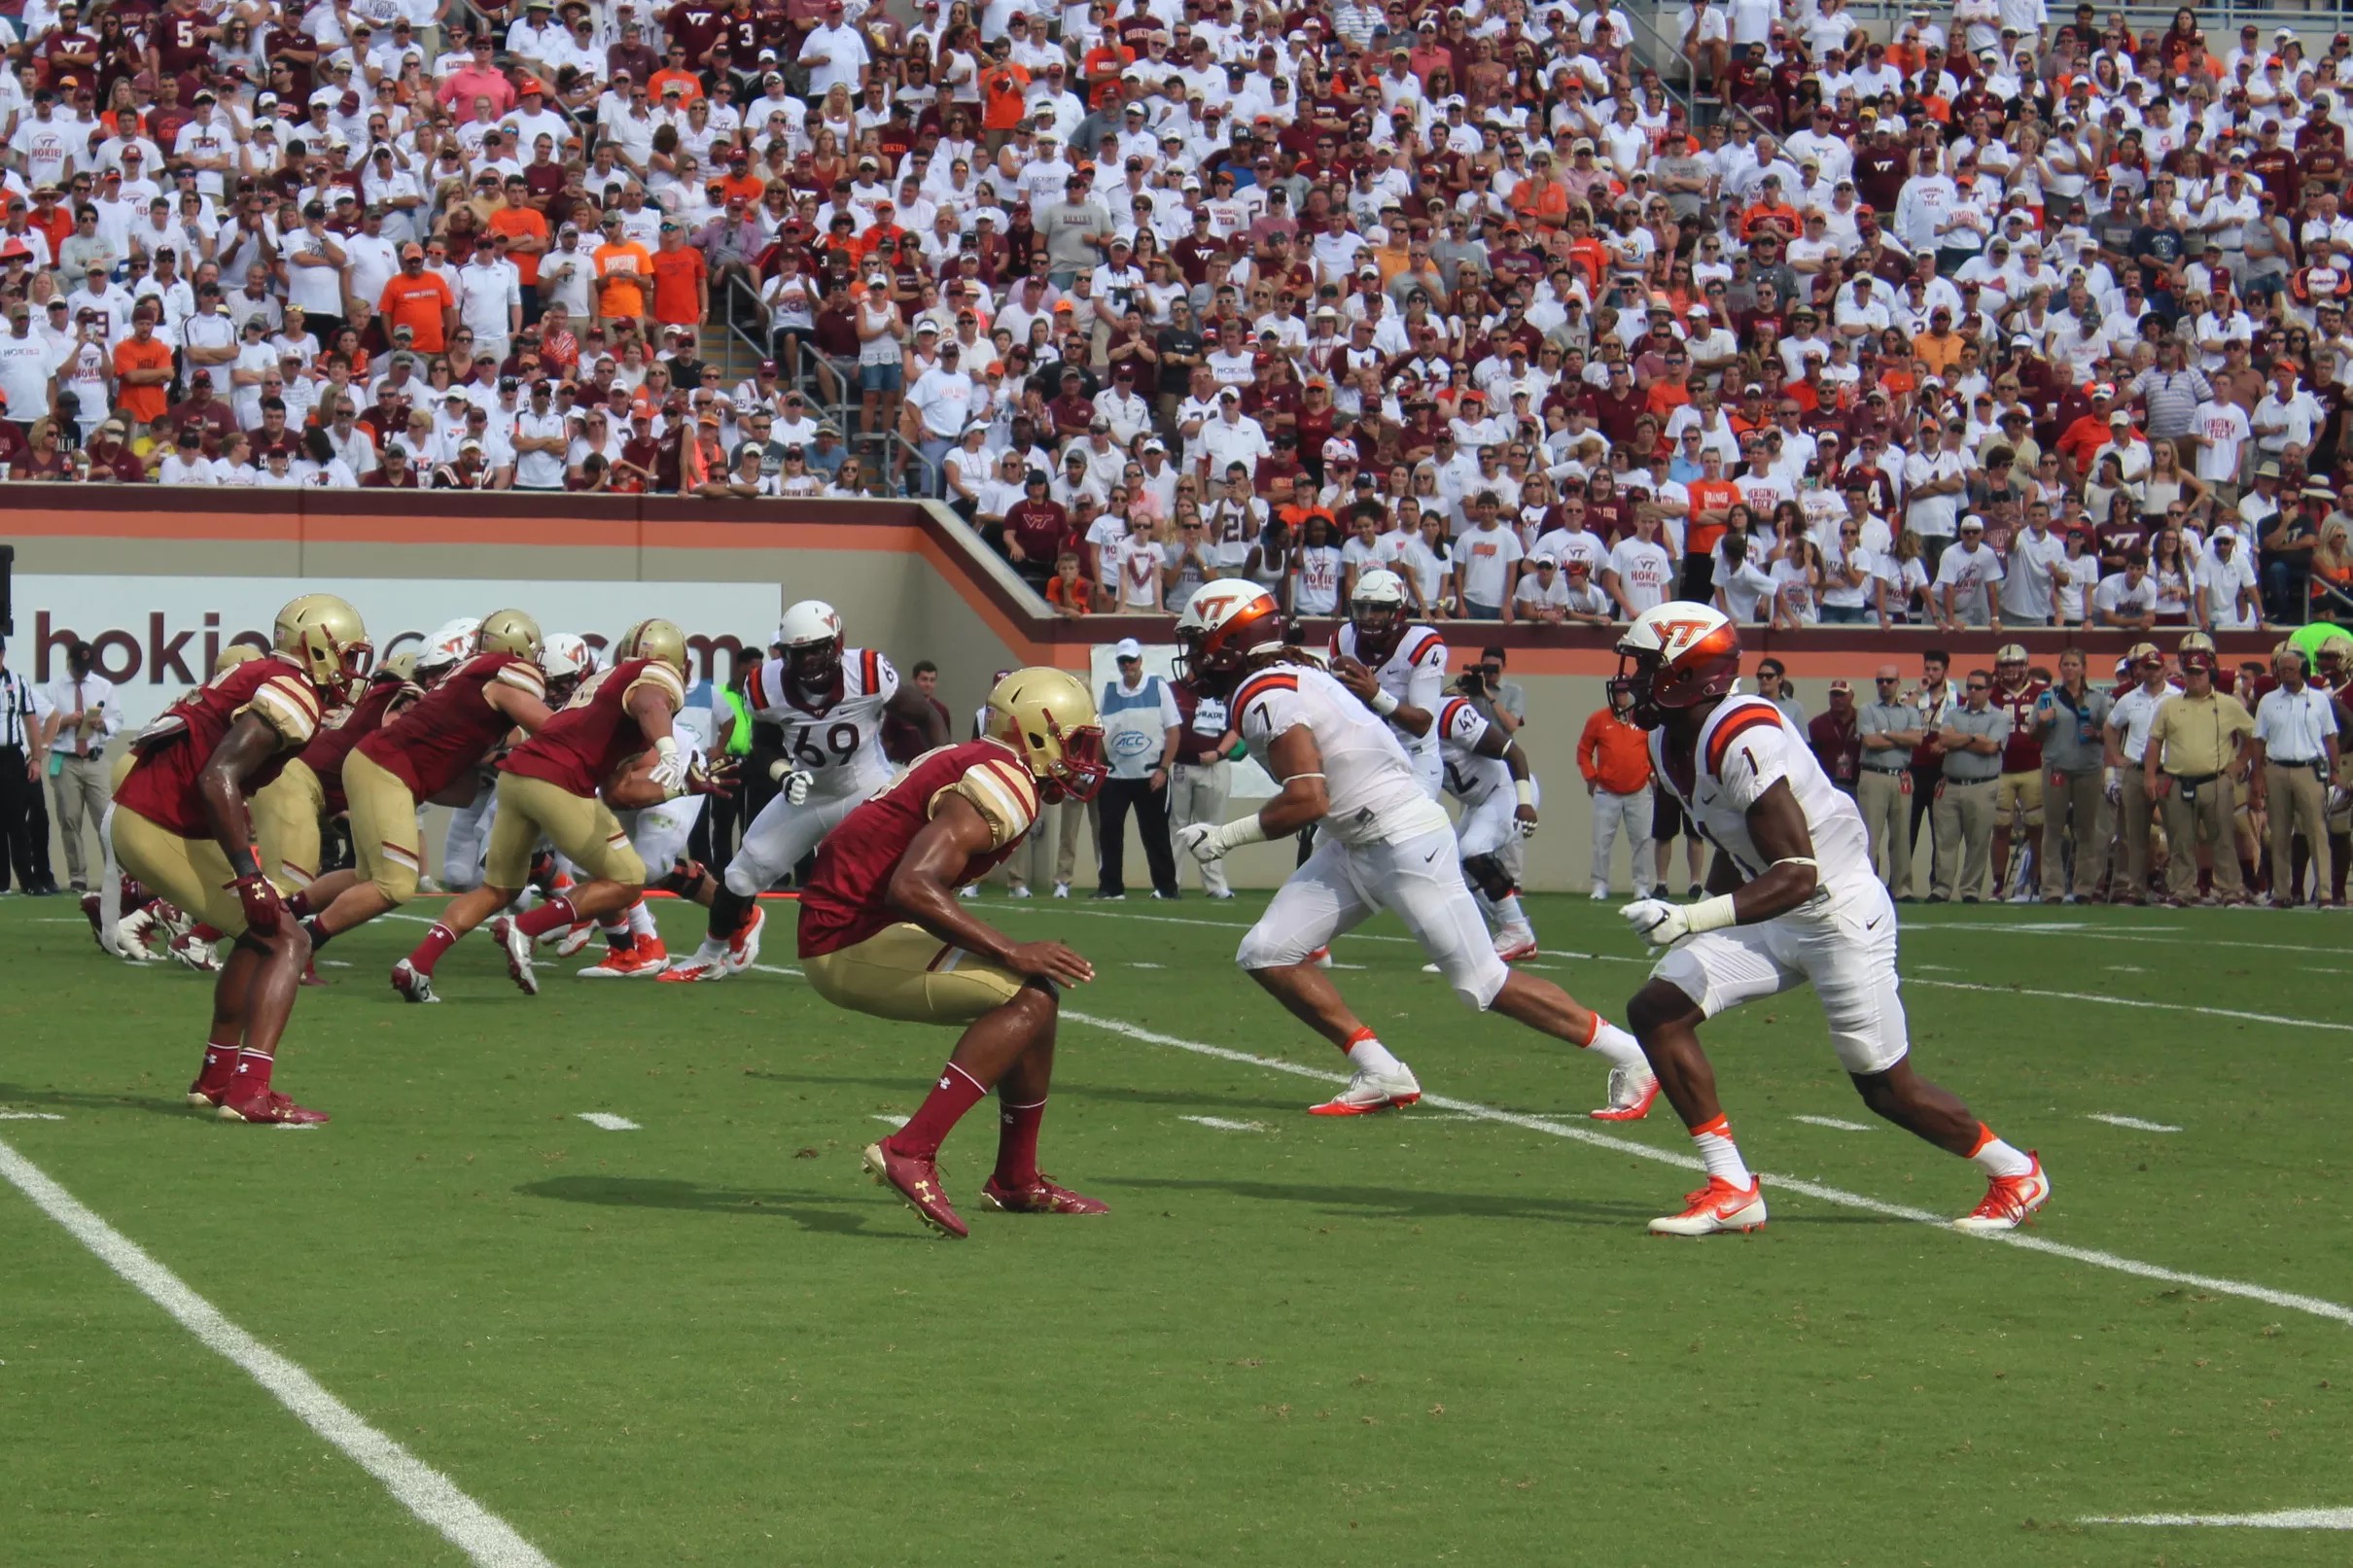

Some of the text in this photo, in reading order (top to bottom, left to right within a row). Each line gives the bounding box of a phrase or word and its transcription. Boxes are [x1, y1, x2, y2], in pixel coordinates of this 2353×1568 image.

[686, 13, 712, 25] VT
[177, 20, 194, 48] 5
[739, 24, 753, 46] 3
[1125, 30, 1151, 41] HOKI
[61, 41, 87, 54] VT
[31, 148, 62, 158] HOKIES
[1874, 161, 1893, 171] VT
[1194, 249, 1214, 260] VT
[820, 257, 827, 267] 3
[83, 357, 97, 366] VT
[75, 368, 101, 379] HOKI
[2203, 420, 2235, 431] VIRGINIA
[2210, 430, 2232, 439] TECH
[1704, 492, 1729, 503] ORANGE
[1869, 482, 1882, 509] 4
[1023, 513, 1054, 529] VT
[2106, 534, 2140, 549] VT
[1569, 548, 1585, 558] VT
[1638, 559, 1656, 570] VT
[1194, 596, 1238, 622] VT
[1651, 620, 1710, 646] VT
[438, 637, 464, 656] VT
[1430, 651, 1440, 667] 4
[1195, 711, 1225, 720] RADE
[1252, 703, 1271, 730] 7
[1459, 710, 1477, 732] 42
[794, 722, 860, 768] 69
[1116, 736, 1151, 748] ACC
[1741, 747, 1758, 776] 1
